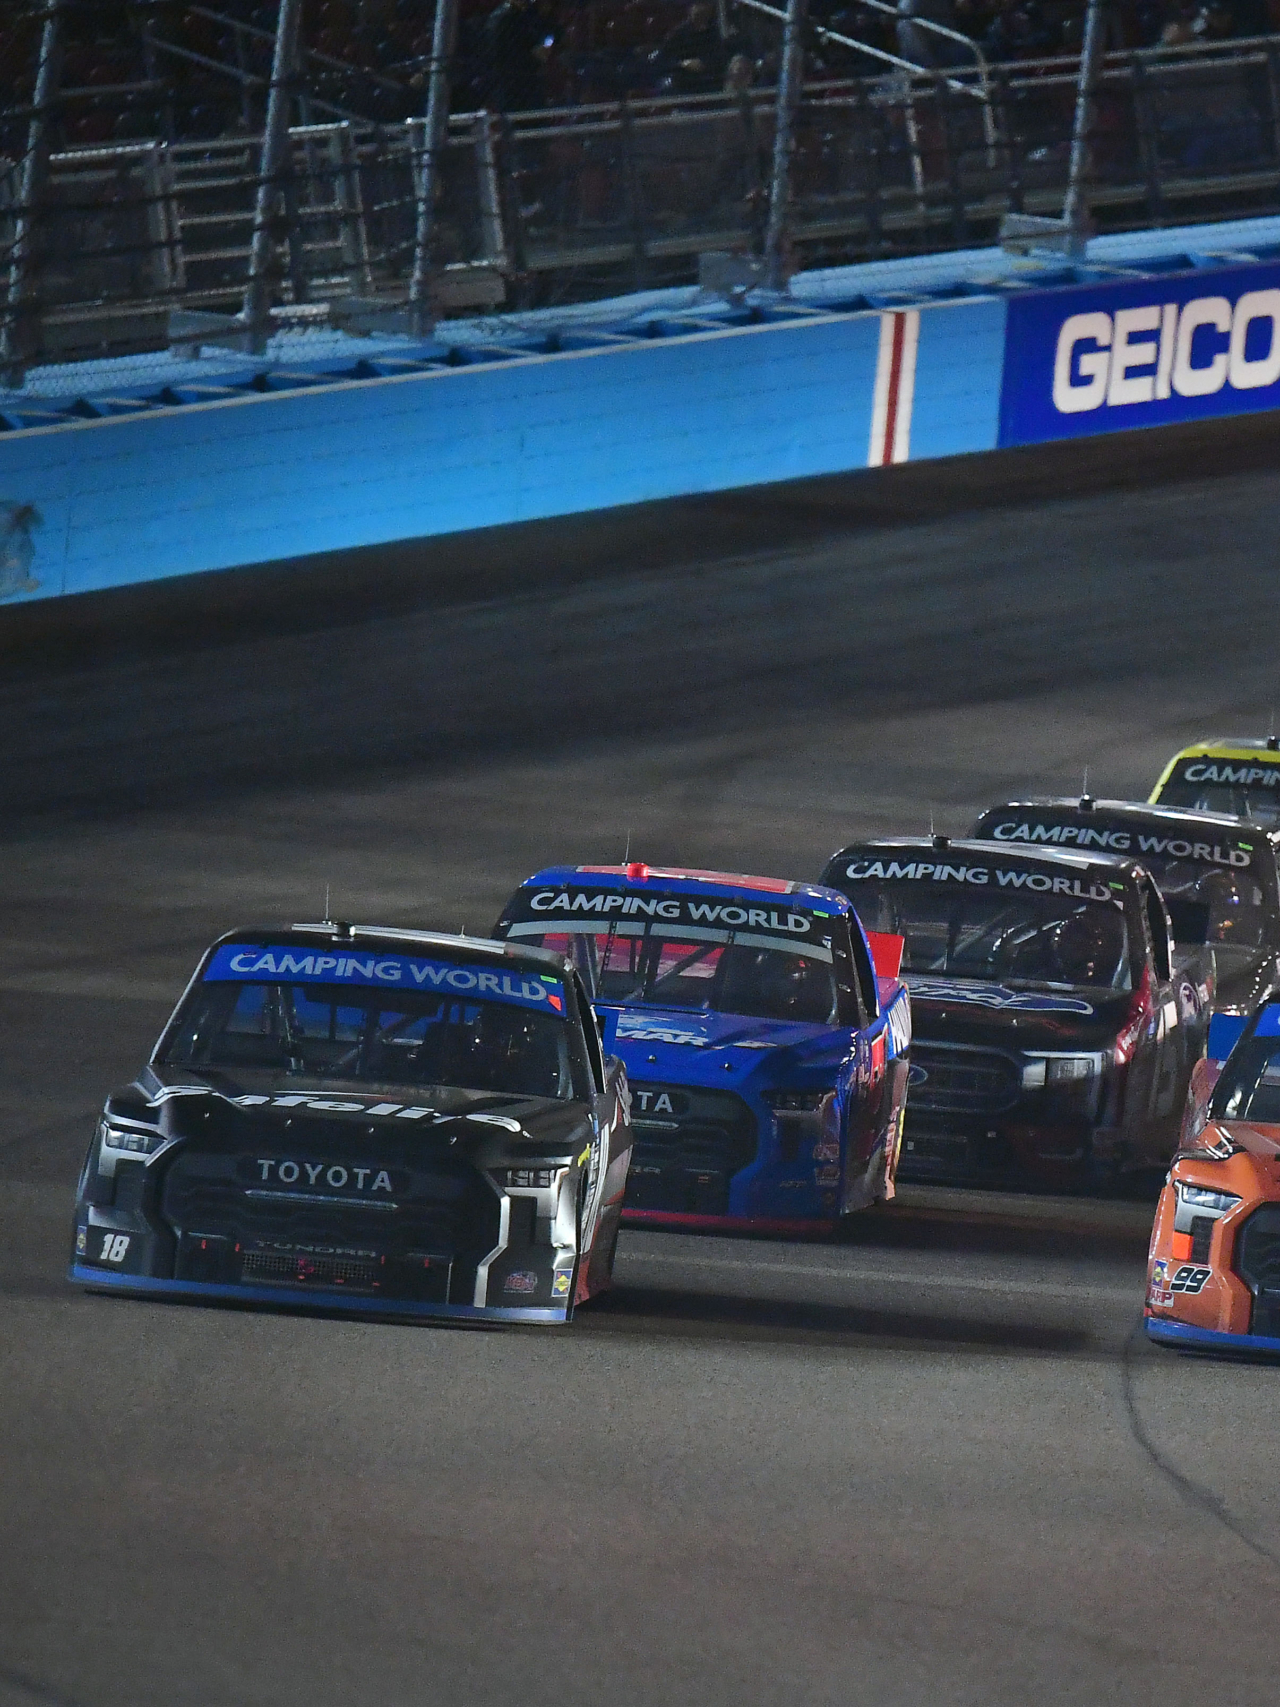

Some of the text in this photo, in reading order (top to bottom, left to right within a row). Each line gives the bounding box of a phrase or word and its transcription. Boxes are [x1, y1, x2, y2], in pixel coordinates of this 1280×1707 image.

[993, 821, 1251, 868] CAMPING WORLD
[845, 860, 1112, 902] CAMPING WORLD
[530, 891, 812, 934] CAMPING WORLD
[229, 951, 548, 1002] CAMPING WORLD
[257, 1158, 395, 1193] TOYOTA
[99, 1233, 131, 1263] 18
[1169, 1265, 1213, 1295] 99
